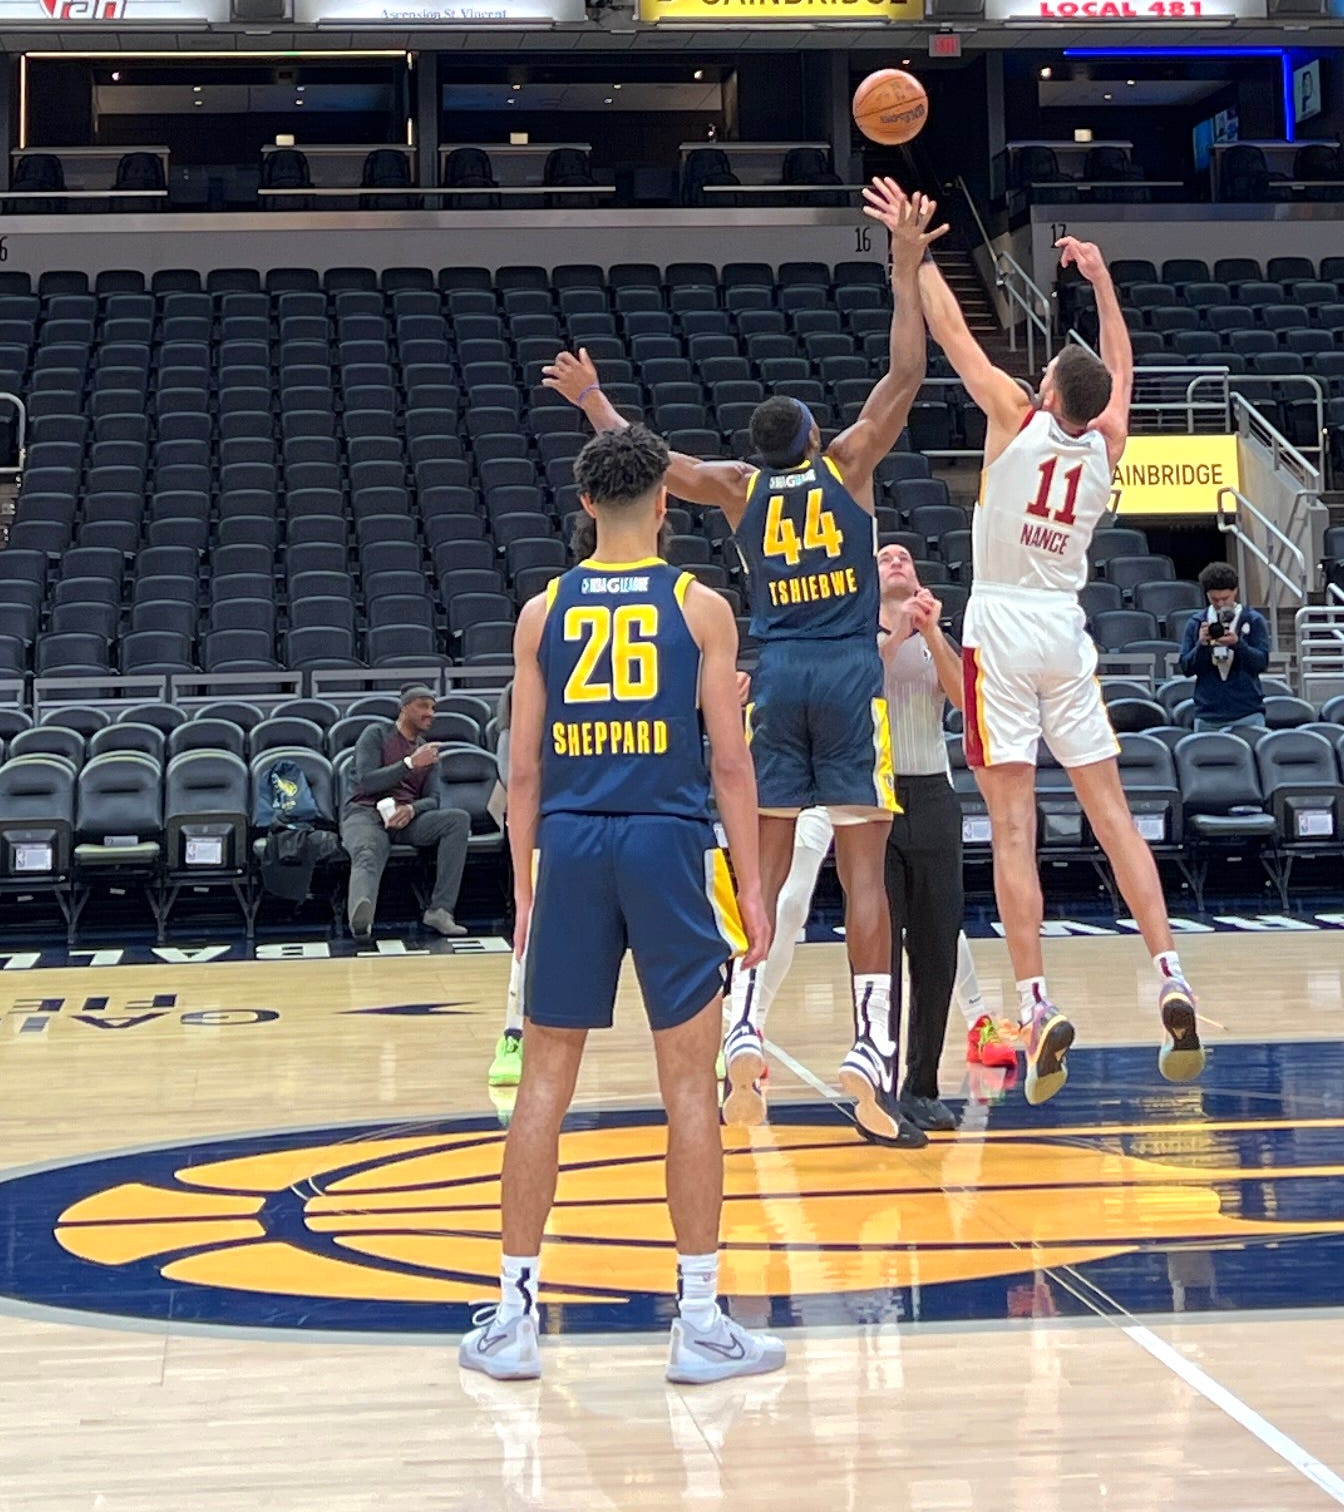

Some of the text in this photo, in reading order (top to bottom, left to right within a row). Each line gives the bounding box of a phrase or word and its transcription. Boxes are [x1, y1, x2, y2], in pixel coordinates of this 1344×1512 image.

[1039, 1, 1203, 18] LOCAL 481
[854, 227, 872, 253] 16
[1026, 455, 1086, 527] 11
[763, 488, 844, 566] 44
[1019, 523, 1071, 556] NANCE
[768, 567, 858, 607] TSHIEBWE
[563, 603, 658, 704] 26
[552, 719, 668, 758] SHEPPARD
